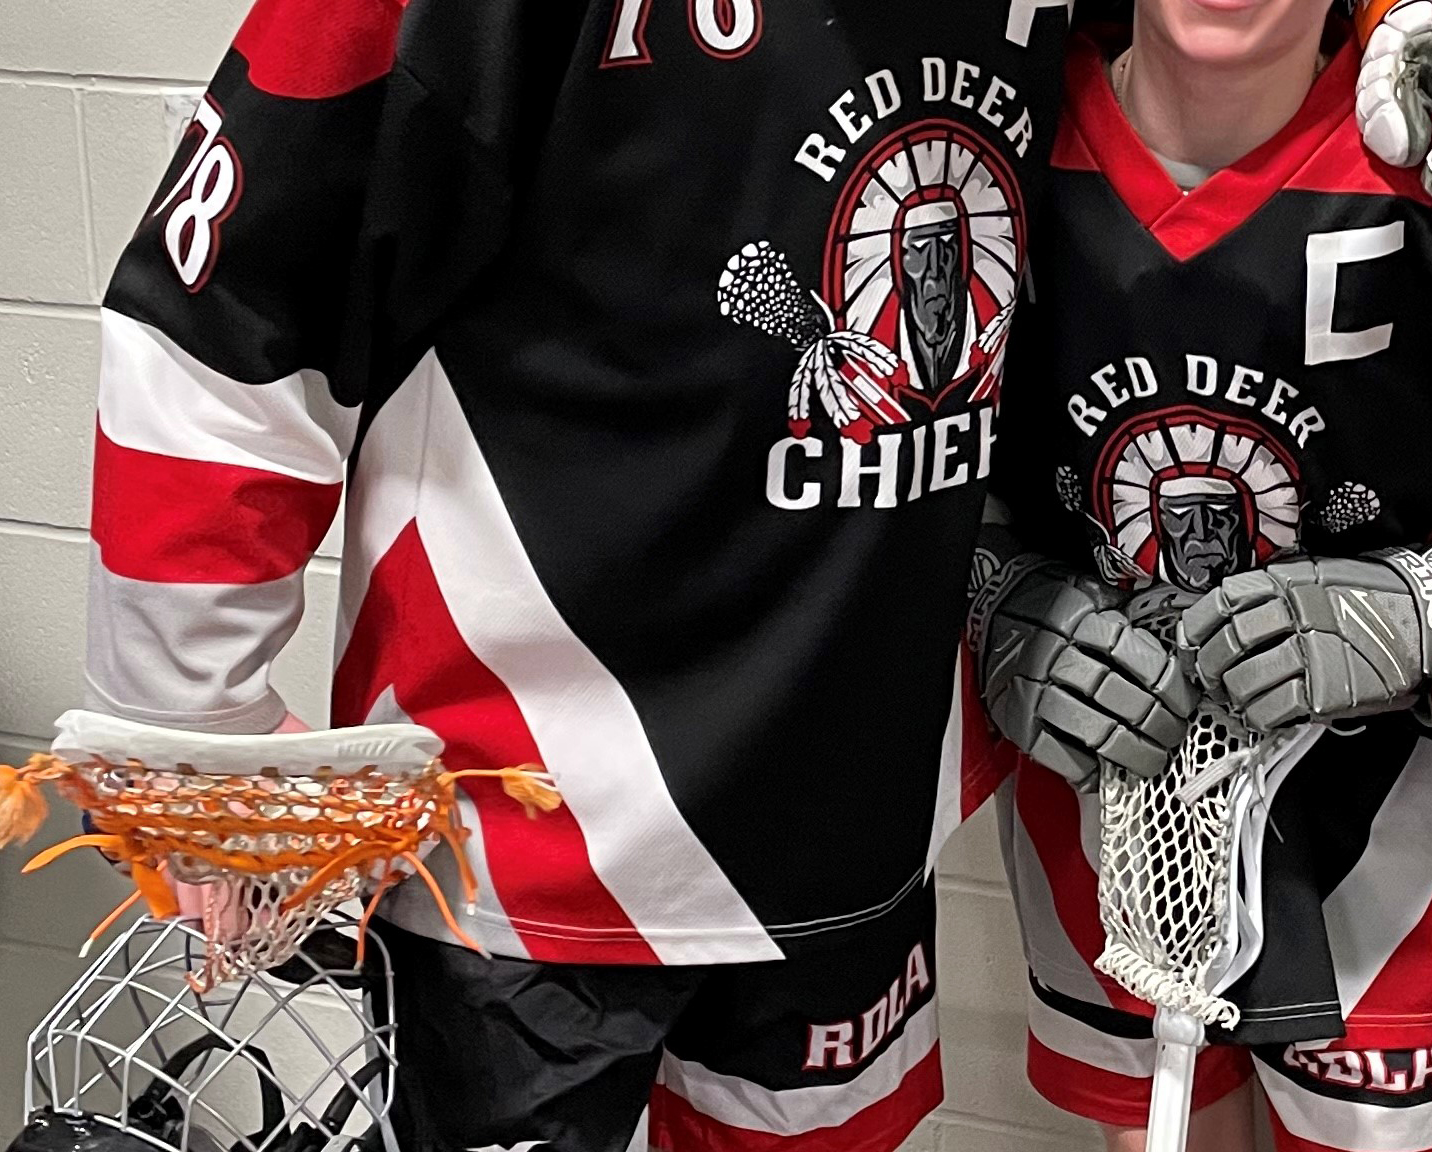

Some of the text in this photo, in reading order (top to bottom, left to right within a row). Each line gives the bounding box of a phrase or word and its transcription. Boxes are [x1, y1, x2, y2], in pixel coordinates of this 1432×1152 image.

[793, 56, 1033, 183] RED DEER
[150, 90, 245, 295] 78
[1304, 220, 1405, 366] C
[765, 406, 999, 511] CHIEF
[1066, 353, 1327, 450] RED DEER
[801, 939, 931, 1071] RDLA
